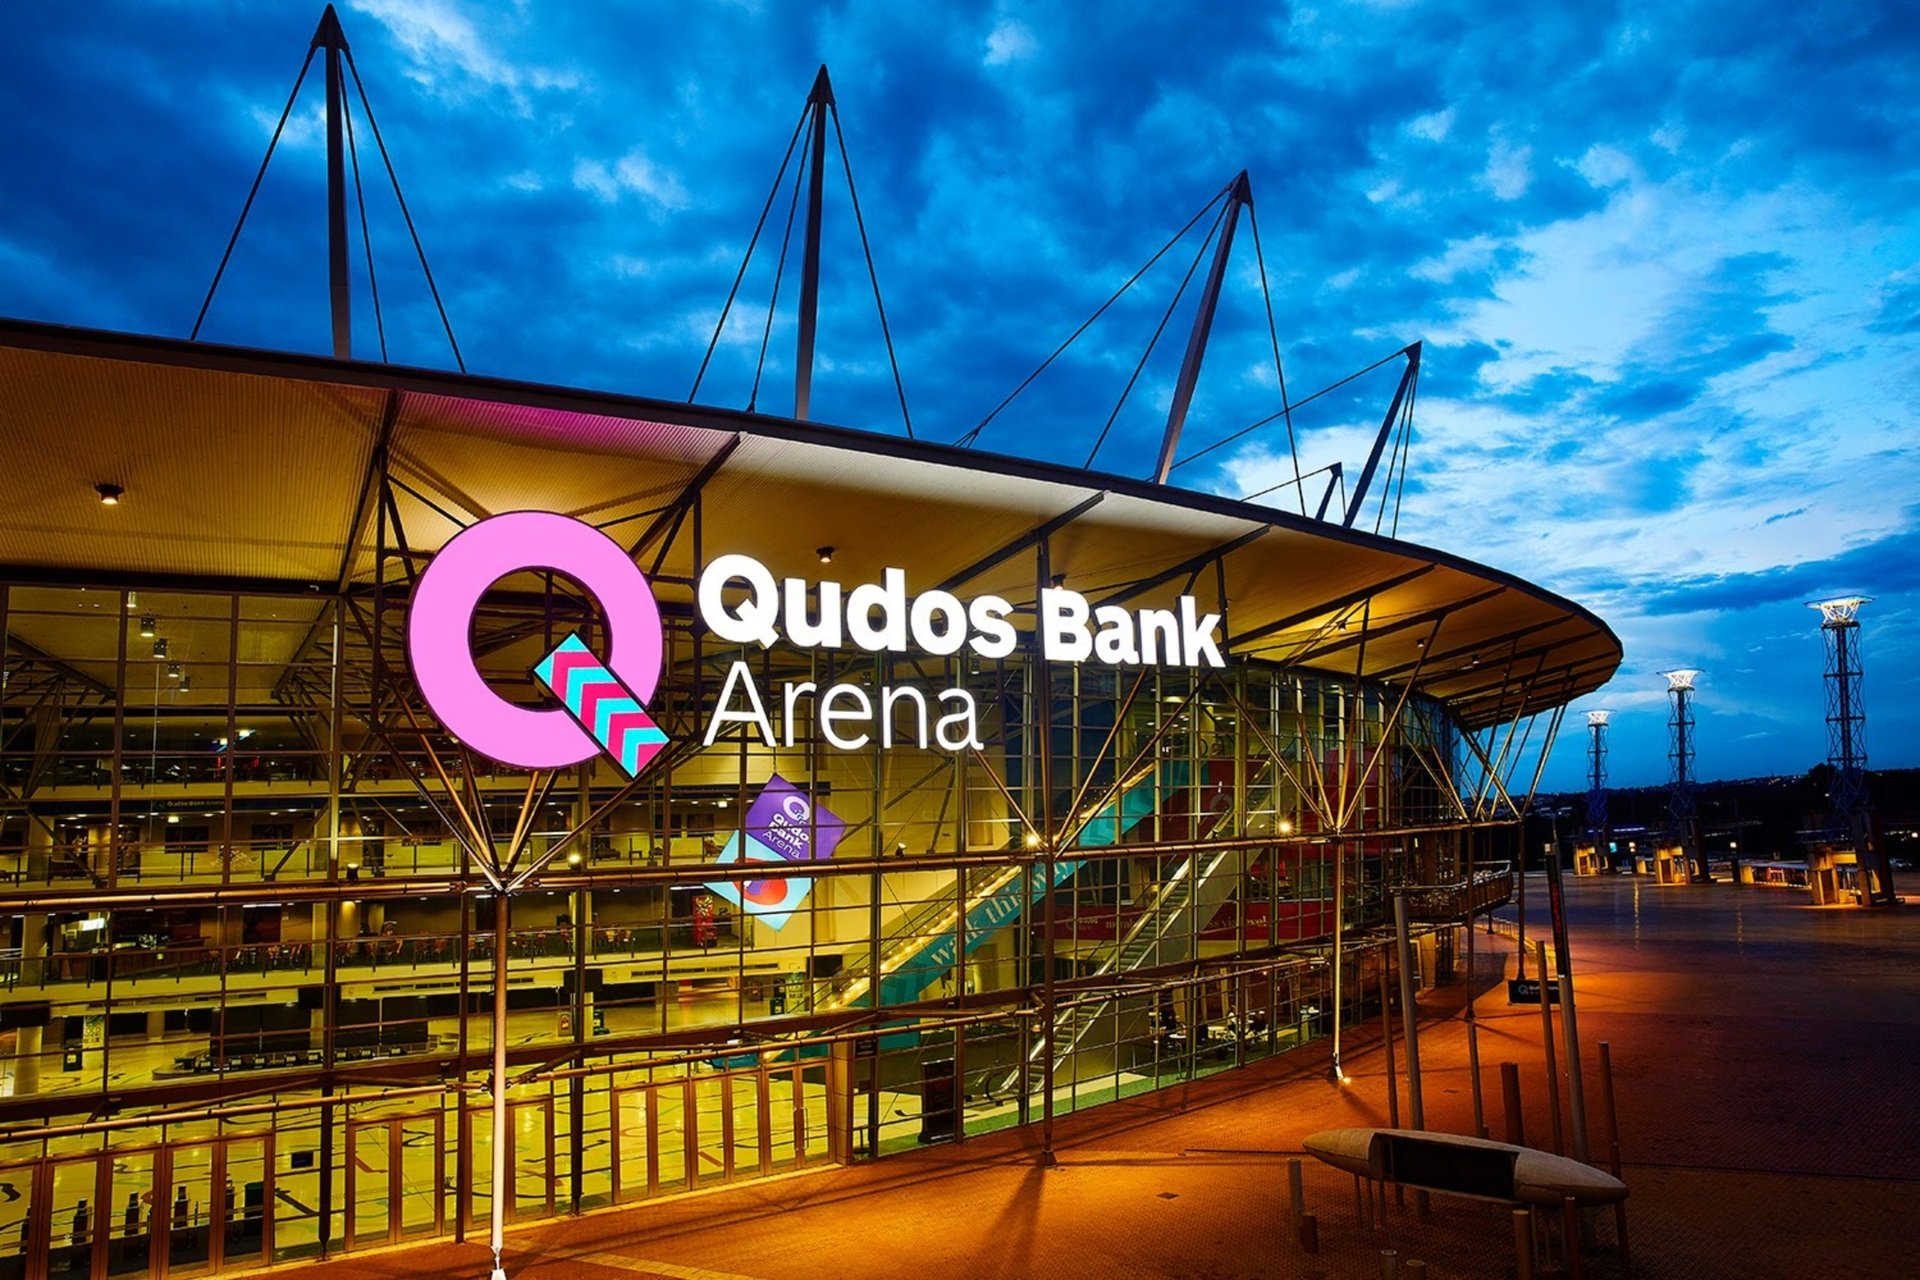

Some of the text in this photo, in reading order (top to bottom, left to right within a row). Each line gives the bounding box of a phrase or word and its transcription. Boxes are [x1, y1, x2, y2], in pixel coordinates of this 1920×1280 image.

[698, 553, 1226, 668] Qudos Bank
[702, 660, 985, 751] Arena
[762, 831, 800, 858] Arena
[773, 813, 810, 844] Qudo
